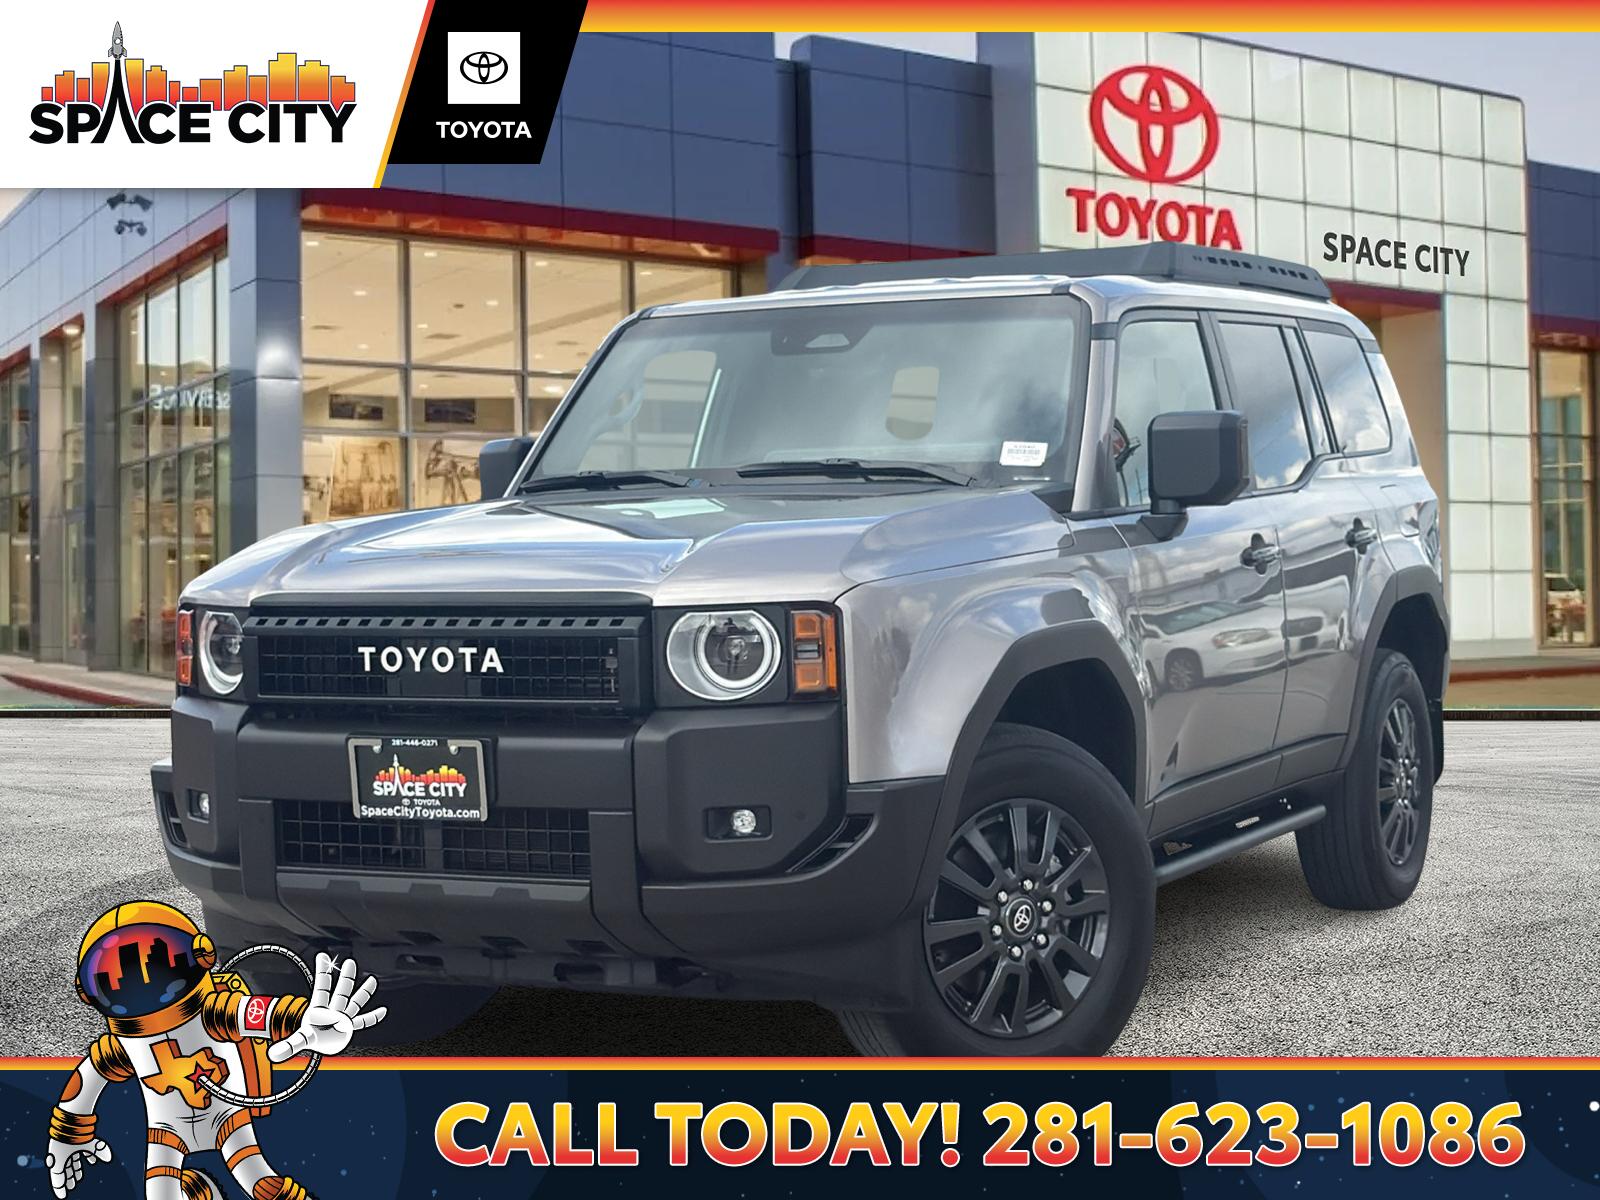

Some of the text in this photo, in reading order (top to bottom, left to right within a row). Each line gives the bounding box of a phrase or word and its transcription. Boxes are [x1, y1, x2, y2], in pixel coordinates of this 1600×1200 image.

[1066, 187, 1242, 251] TOYOTA
[1323, 232, 1470, 277] SPACE CITY
[357, 646, 504, 673] TOYOTA
[391, 738, 438, 747] 281-446-0271
[372, 781, 467, 798] SPACE CITY
[361, 805, 480, 819] SpaceCityToyota.com
